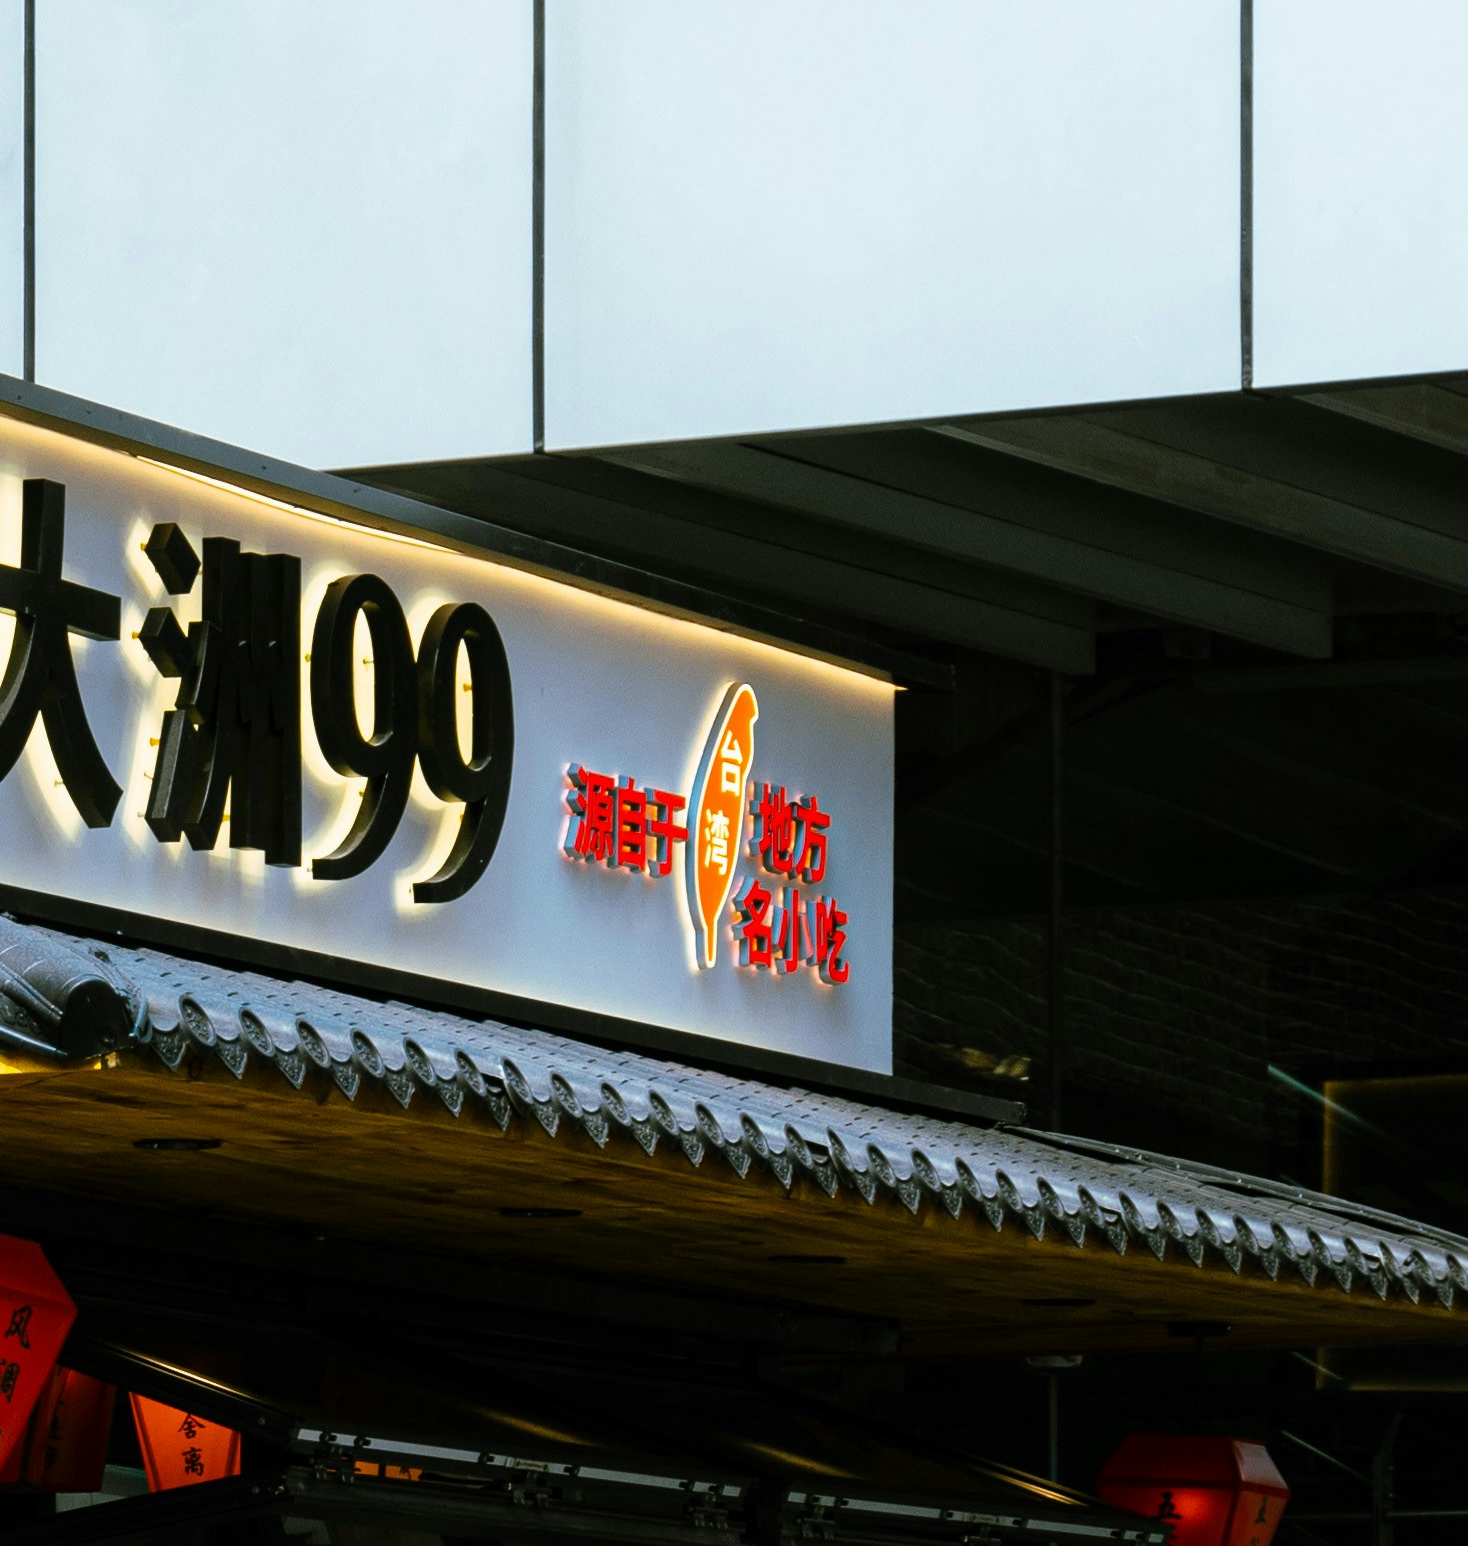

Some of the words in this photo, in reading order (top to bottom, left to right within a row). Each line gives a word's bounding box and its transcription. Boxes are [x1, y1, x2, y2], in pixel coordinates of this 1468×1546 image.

[564, 763, 689, 878] 源自于
[705, 730, 743, 876] 台湾
[749, 781, 831, 884] 地方
[733, 877, 849, 984] 名小吃
